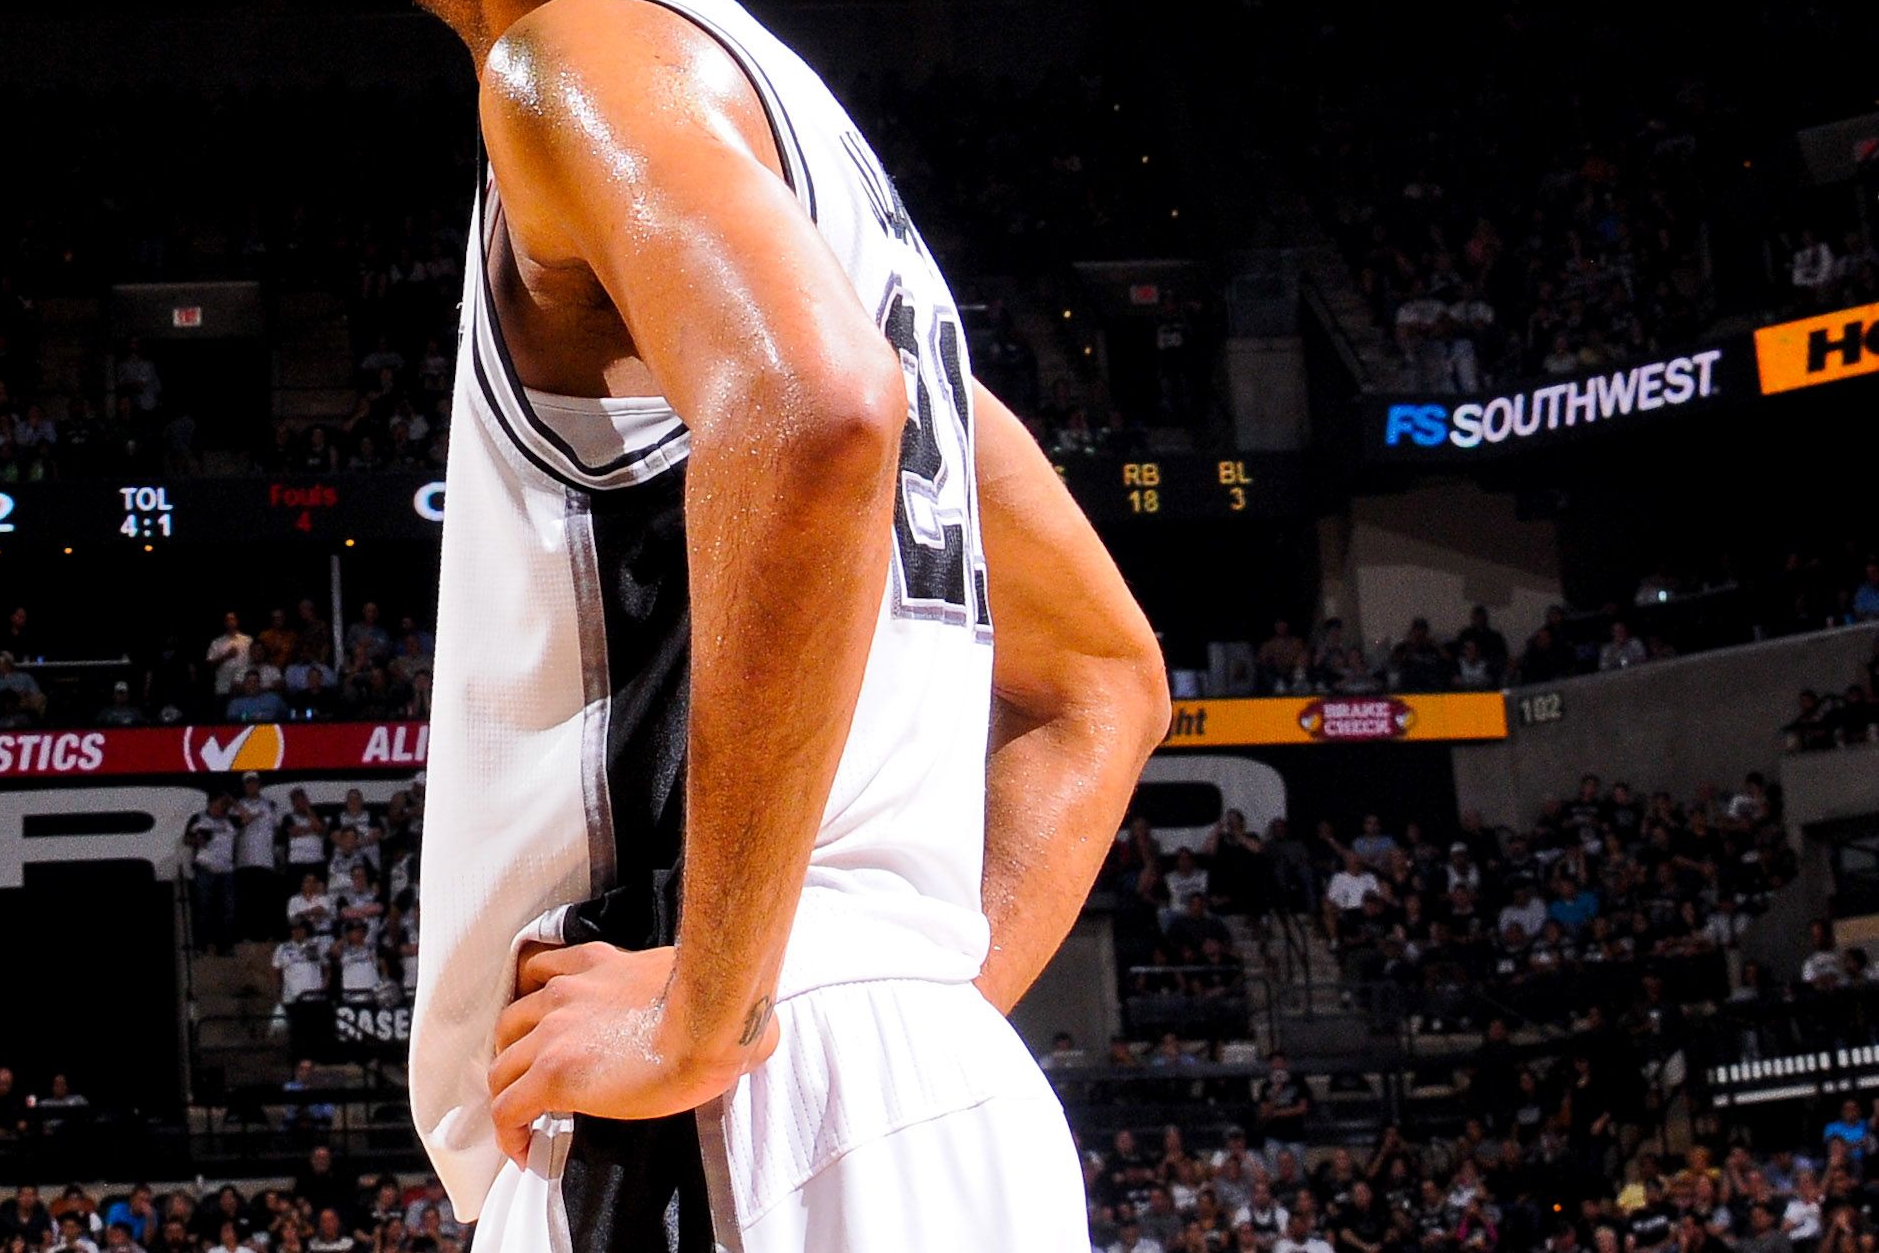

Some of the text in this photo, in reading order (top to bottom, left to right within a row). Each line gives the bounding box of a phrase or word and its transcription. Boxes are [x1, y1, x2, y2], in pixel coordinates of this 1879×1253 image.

[1449, 350, 1722, 449] SOUTHWEST
[1123, 463, 1160, 487] RB
[1218, 460, 1252, 485] BL
[119, 486, 174, 511] TOL
[1128, 489, 1159, 513] 18
[1229, 486, 1246, 511] 3
[120, 512, 172, 538] 4:1
[1176, 707, 1207, 735] ht
